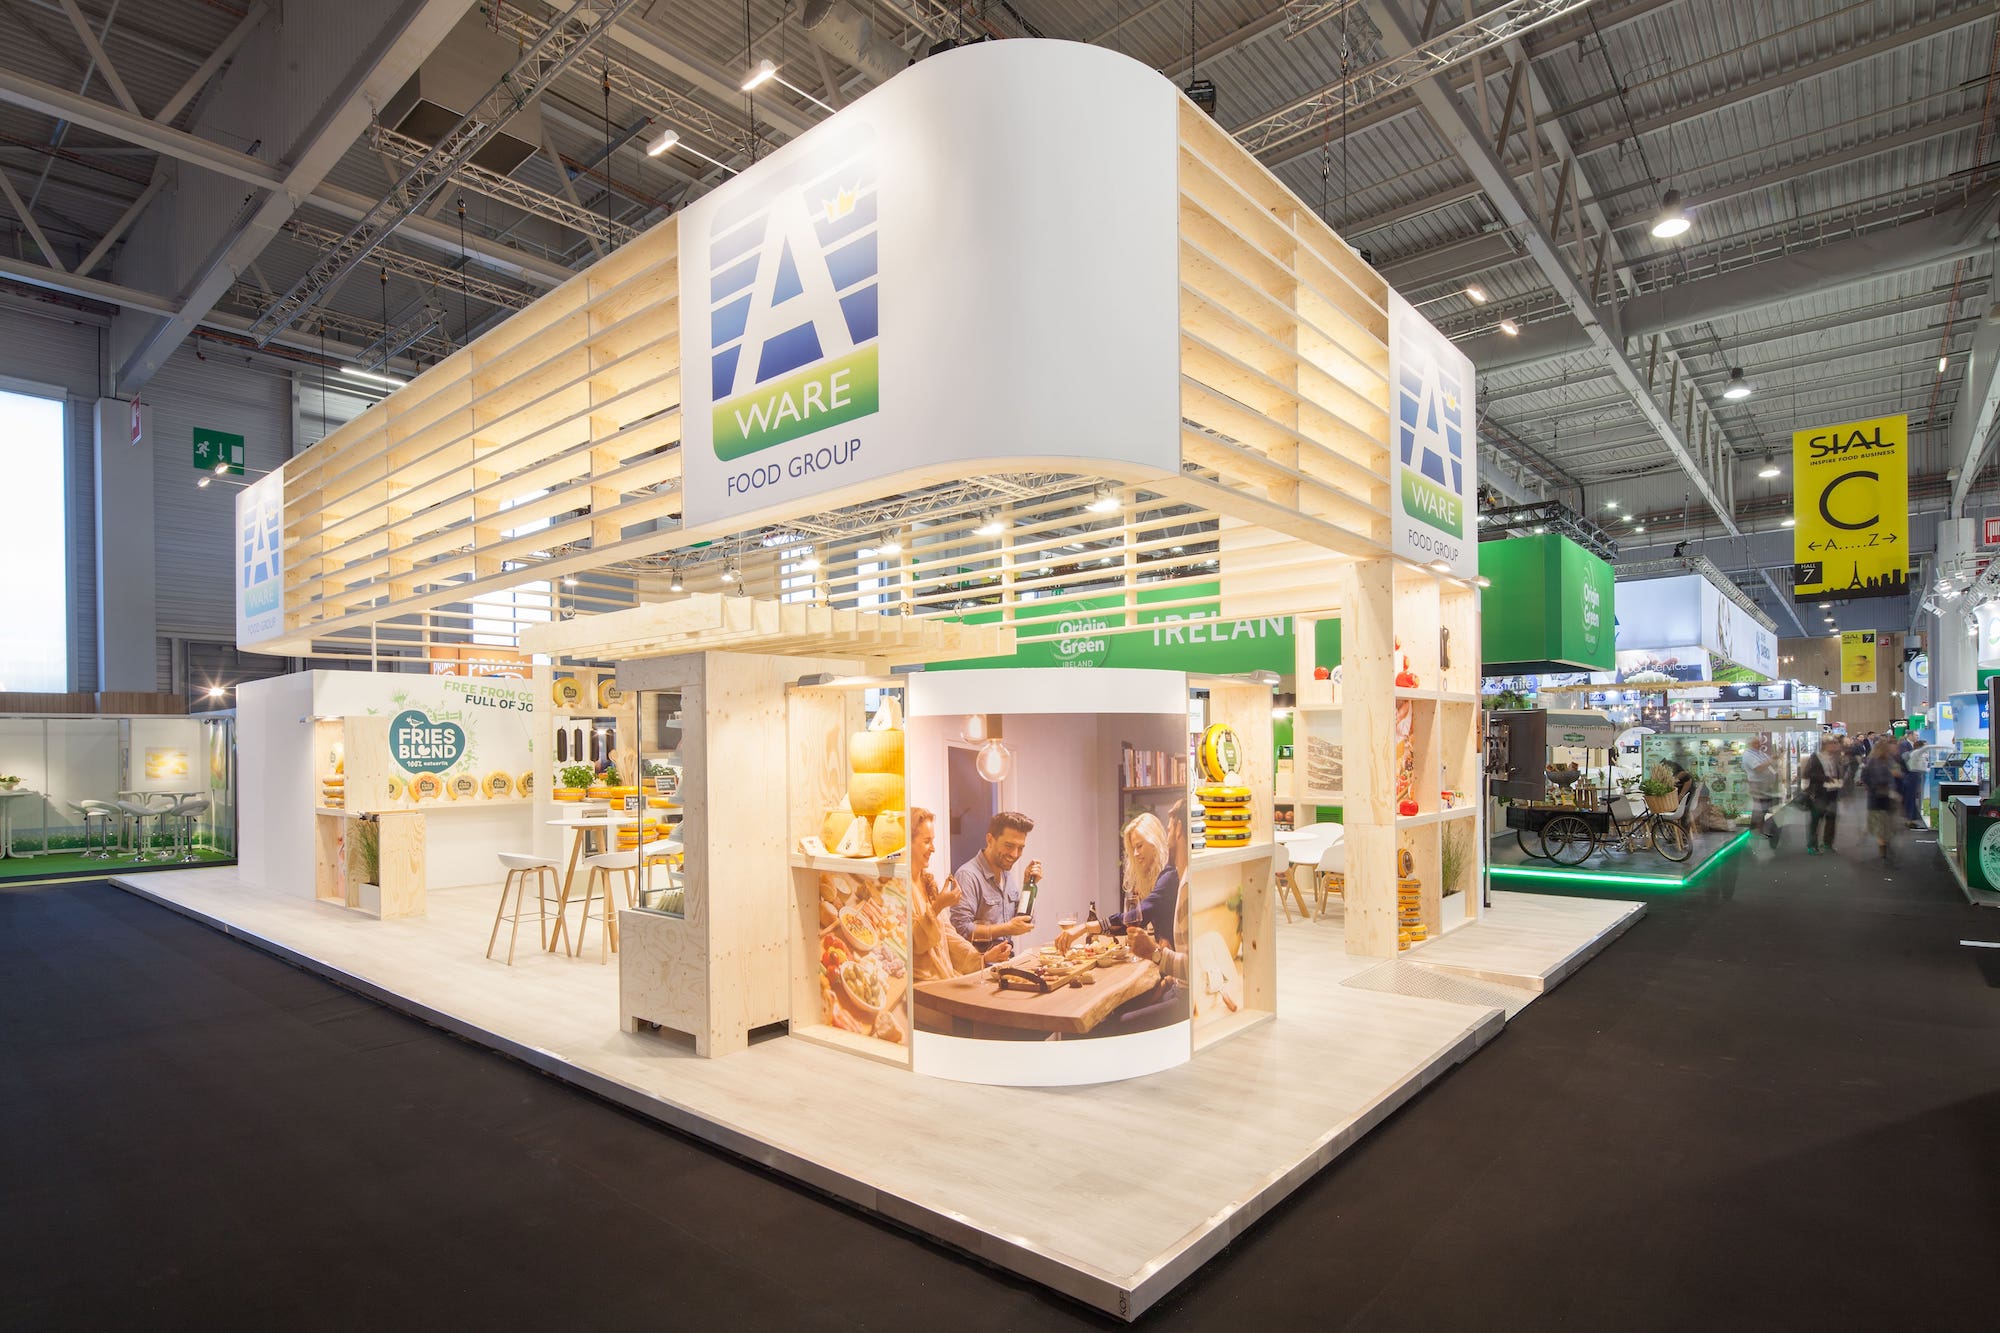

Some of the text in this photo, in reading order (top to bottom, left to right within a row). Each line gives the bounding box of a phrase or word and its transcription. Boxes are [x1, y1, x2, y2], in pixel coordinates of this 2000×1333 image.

[735, 367, 852, 440] WARE
[1809, 426, 1896, 459] SIAL
[727, 438, 862, 497] FOOD GROUP
[1810, 449, 1896, 467] INSPIRE FOOD BUSINESS
[1411, 481, 1456, 527] WARE
[1818, 470, 1880, 531] C
[1408, 528, 1459, 562] FOOD GROUP
[1800, 562, 1816, 570] HALL
[1802, 568, 1816, 583] 7
[249, 587, 275, 608] WARE
[1153, 609, 1296, 647] IRELAN
[1060, 639, 1105, 655] Green
[1907, 651, 1918, 661] 7
[1062, 659, 1094, 668] IRELAND
[443, 680, 478, 695] FREE
[480, 686, 515, 700] FROM
[465, 694, 497, 708] FULL
[499, 699, 517, 710] OF
[398, 728, 456, 745] FRIES
